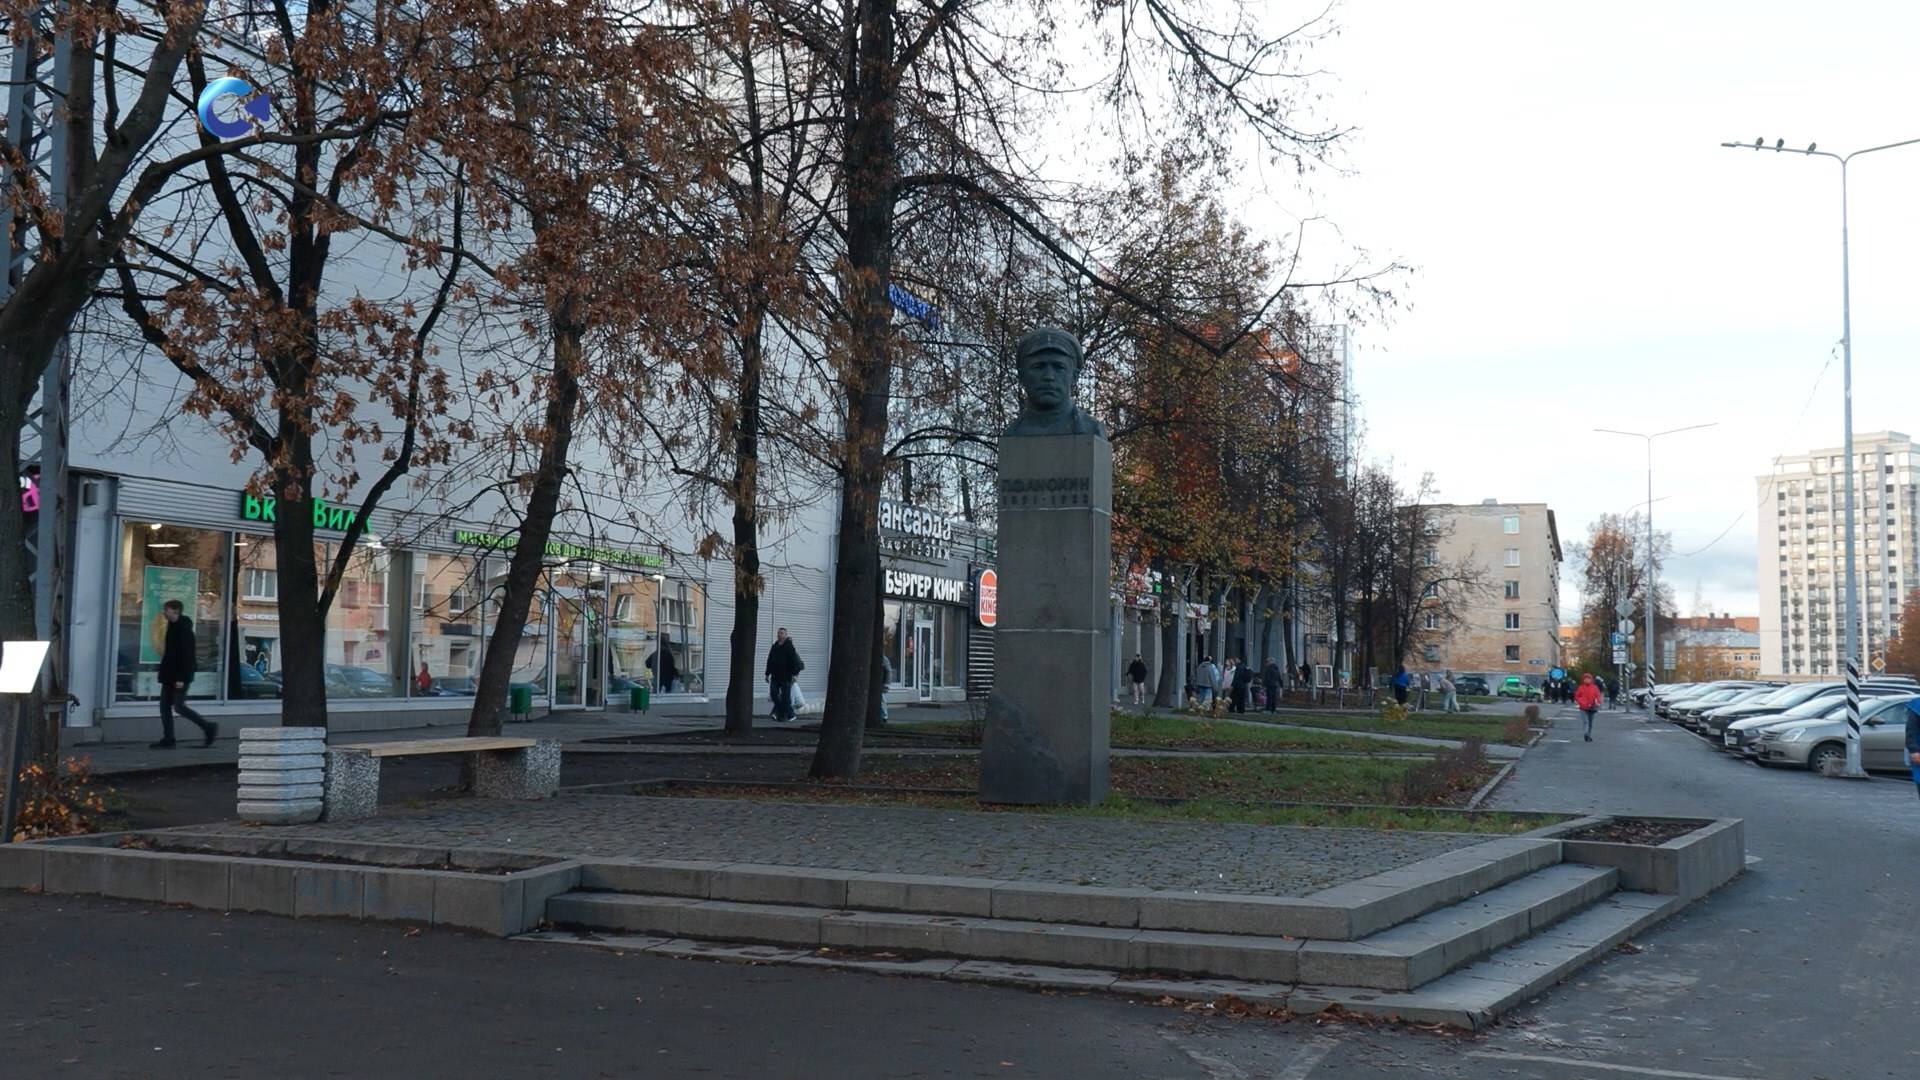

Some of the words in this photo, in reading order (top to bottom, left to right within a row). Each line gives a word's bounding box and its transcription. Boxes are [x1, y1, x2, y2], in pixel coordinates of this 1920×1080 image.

[245, 493, 372, 533] ВкВил
[878, 501, 951, 540] ансарда
[885, 570, 931, 598] БУРГЕР
[933, 577, 963, 603] КИНГ
